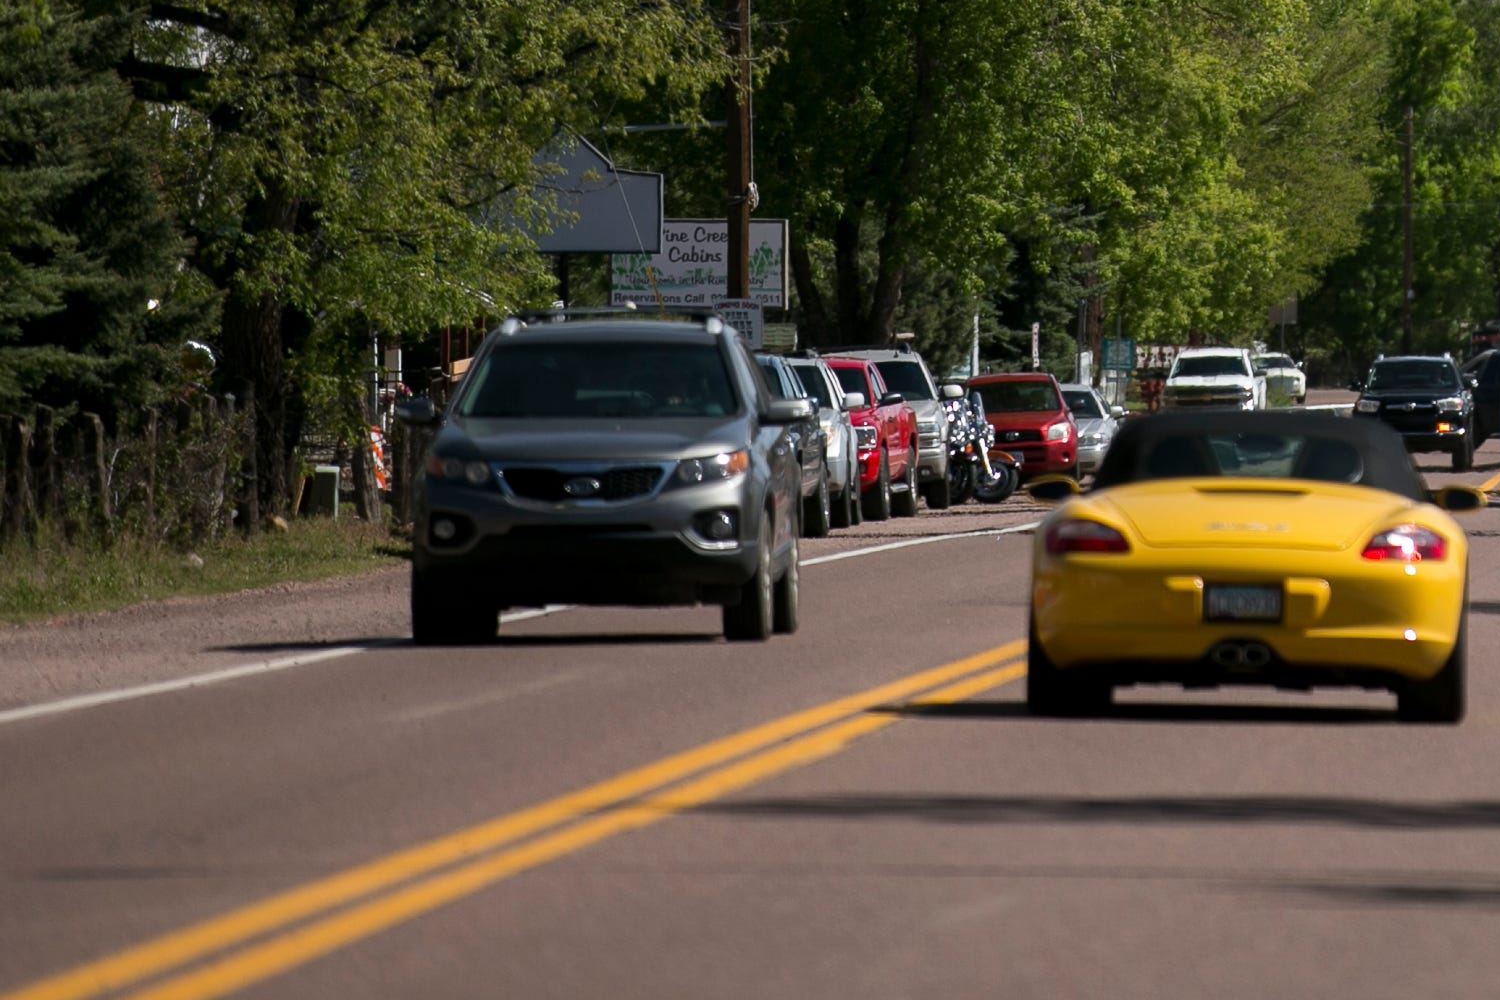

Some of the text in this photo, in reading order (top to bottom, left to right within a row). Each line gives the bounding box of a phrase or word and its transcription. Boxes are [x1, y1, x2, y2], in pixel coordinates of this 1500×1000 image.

[664, 226, 728, 242] ine Cree
[668, 245, 722, 262] Cabins
[613, 292, 682, 304] Reservaons
[685, 292, 705, 304] Call
[1136, 346, 1175, 369] PAR
